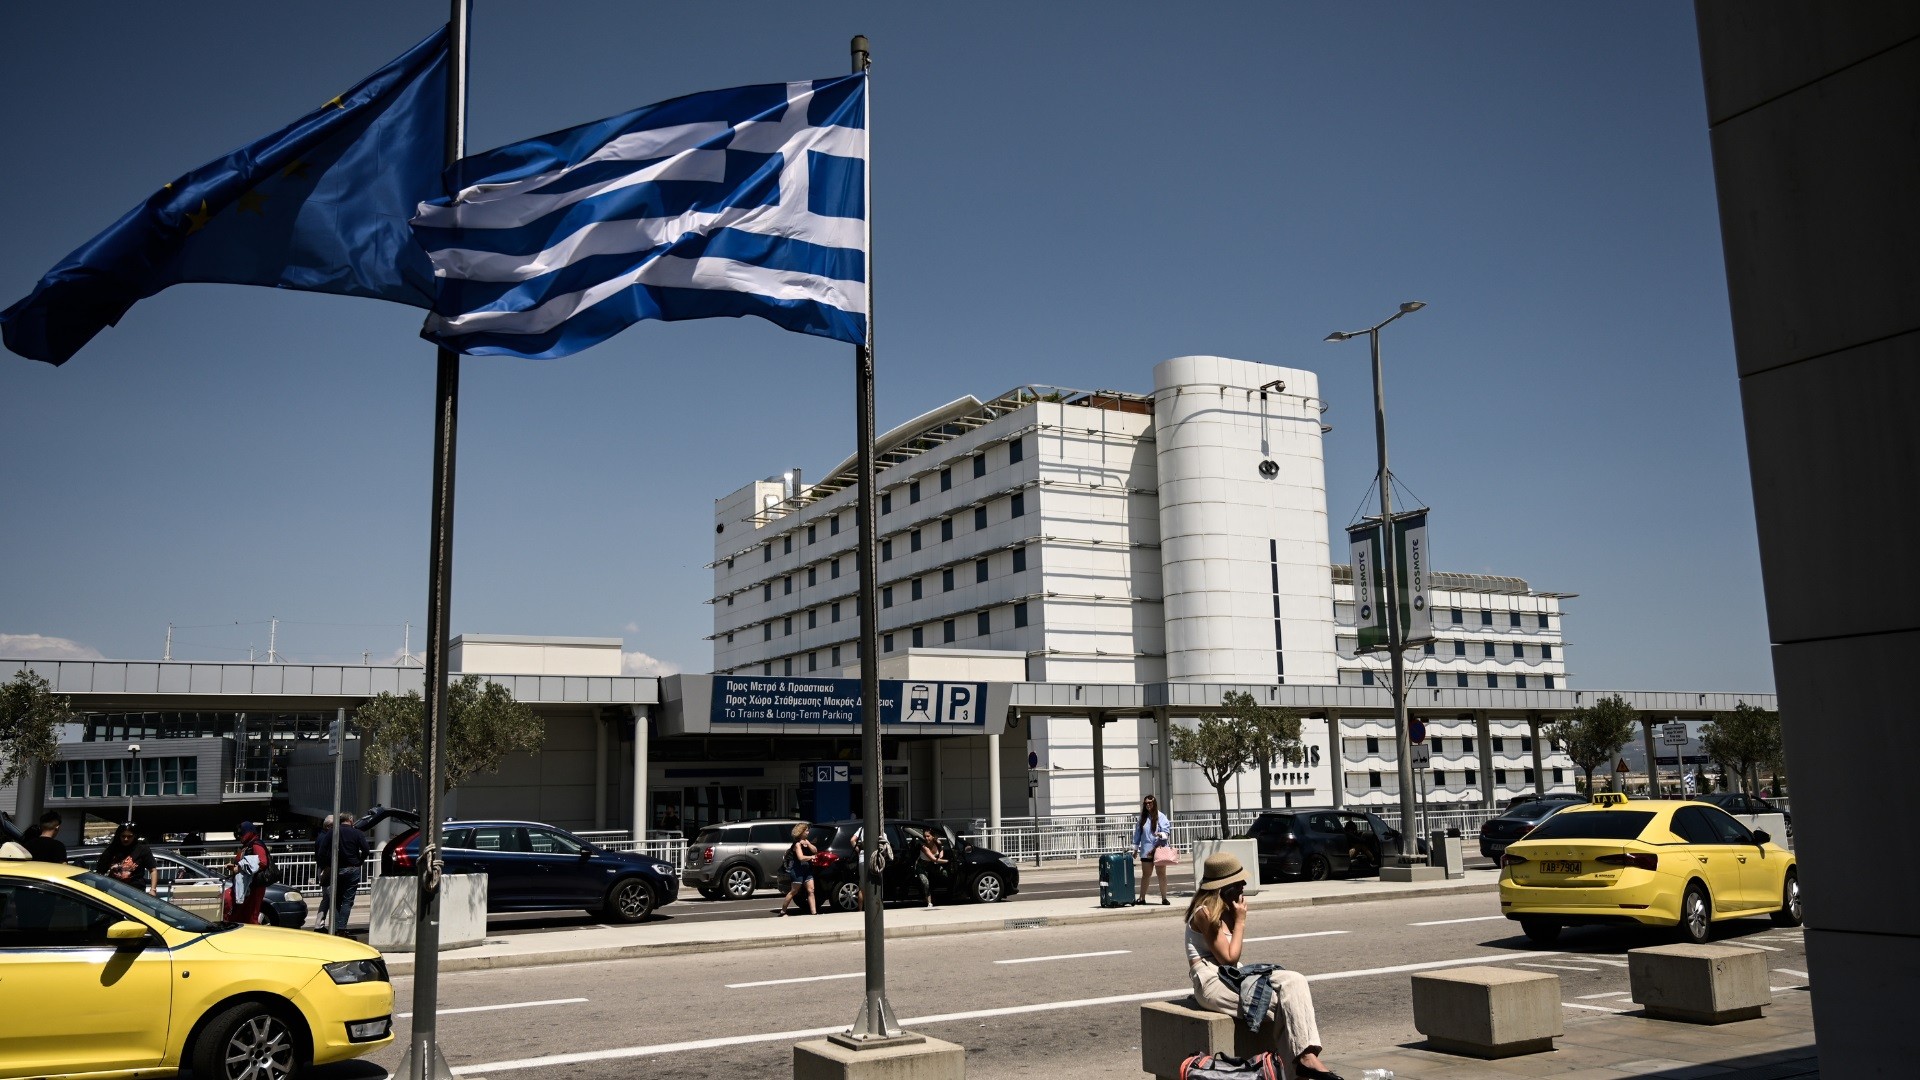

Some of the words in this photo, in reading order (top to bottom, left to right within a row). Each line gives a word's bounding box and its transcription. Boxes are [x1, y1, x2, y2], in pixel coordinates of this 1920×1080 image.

[1412, 539, 1421, 592] COSMOTE
[1358, 551, 1368, 602] COSMOTE
[726, 681, 748, 692] Προς
[750, 681, 777, 693] Μετρό
[779, 682, 785, 691] &
[788, 682, 834, 693] Προαστιακό
[725, 695, 747, 706] Προς
[749, 695, 772, 706] Χώρο
[774, 695, 821, 707] Στάθμευσης
[823, 697, 854, 708] Μακράς
[949, 686, 970, 720] P
[725, 708, 736, 718] To
[738, 708, 765, 718] Trains
[766, 709, 774, 718] &
[776, 709, 820, 720] Long-Term
[822, 710, 853, 721] Parking
[962, 710, 968, 720] 3
[1269, 772, 1310, 784] OTELS
[1596, 795, 1620, 803] TAXI
